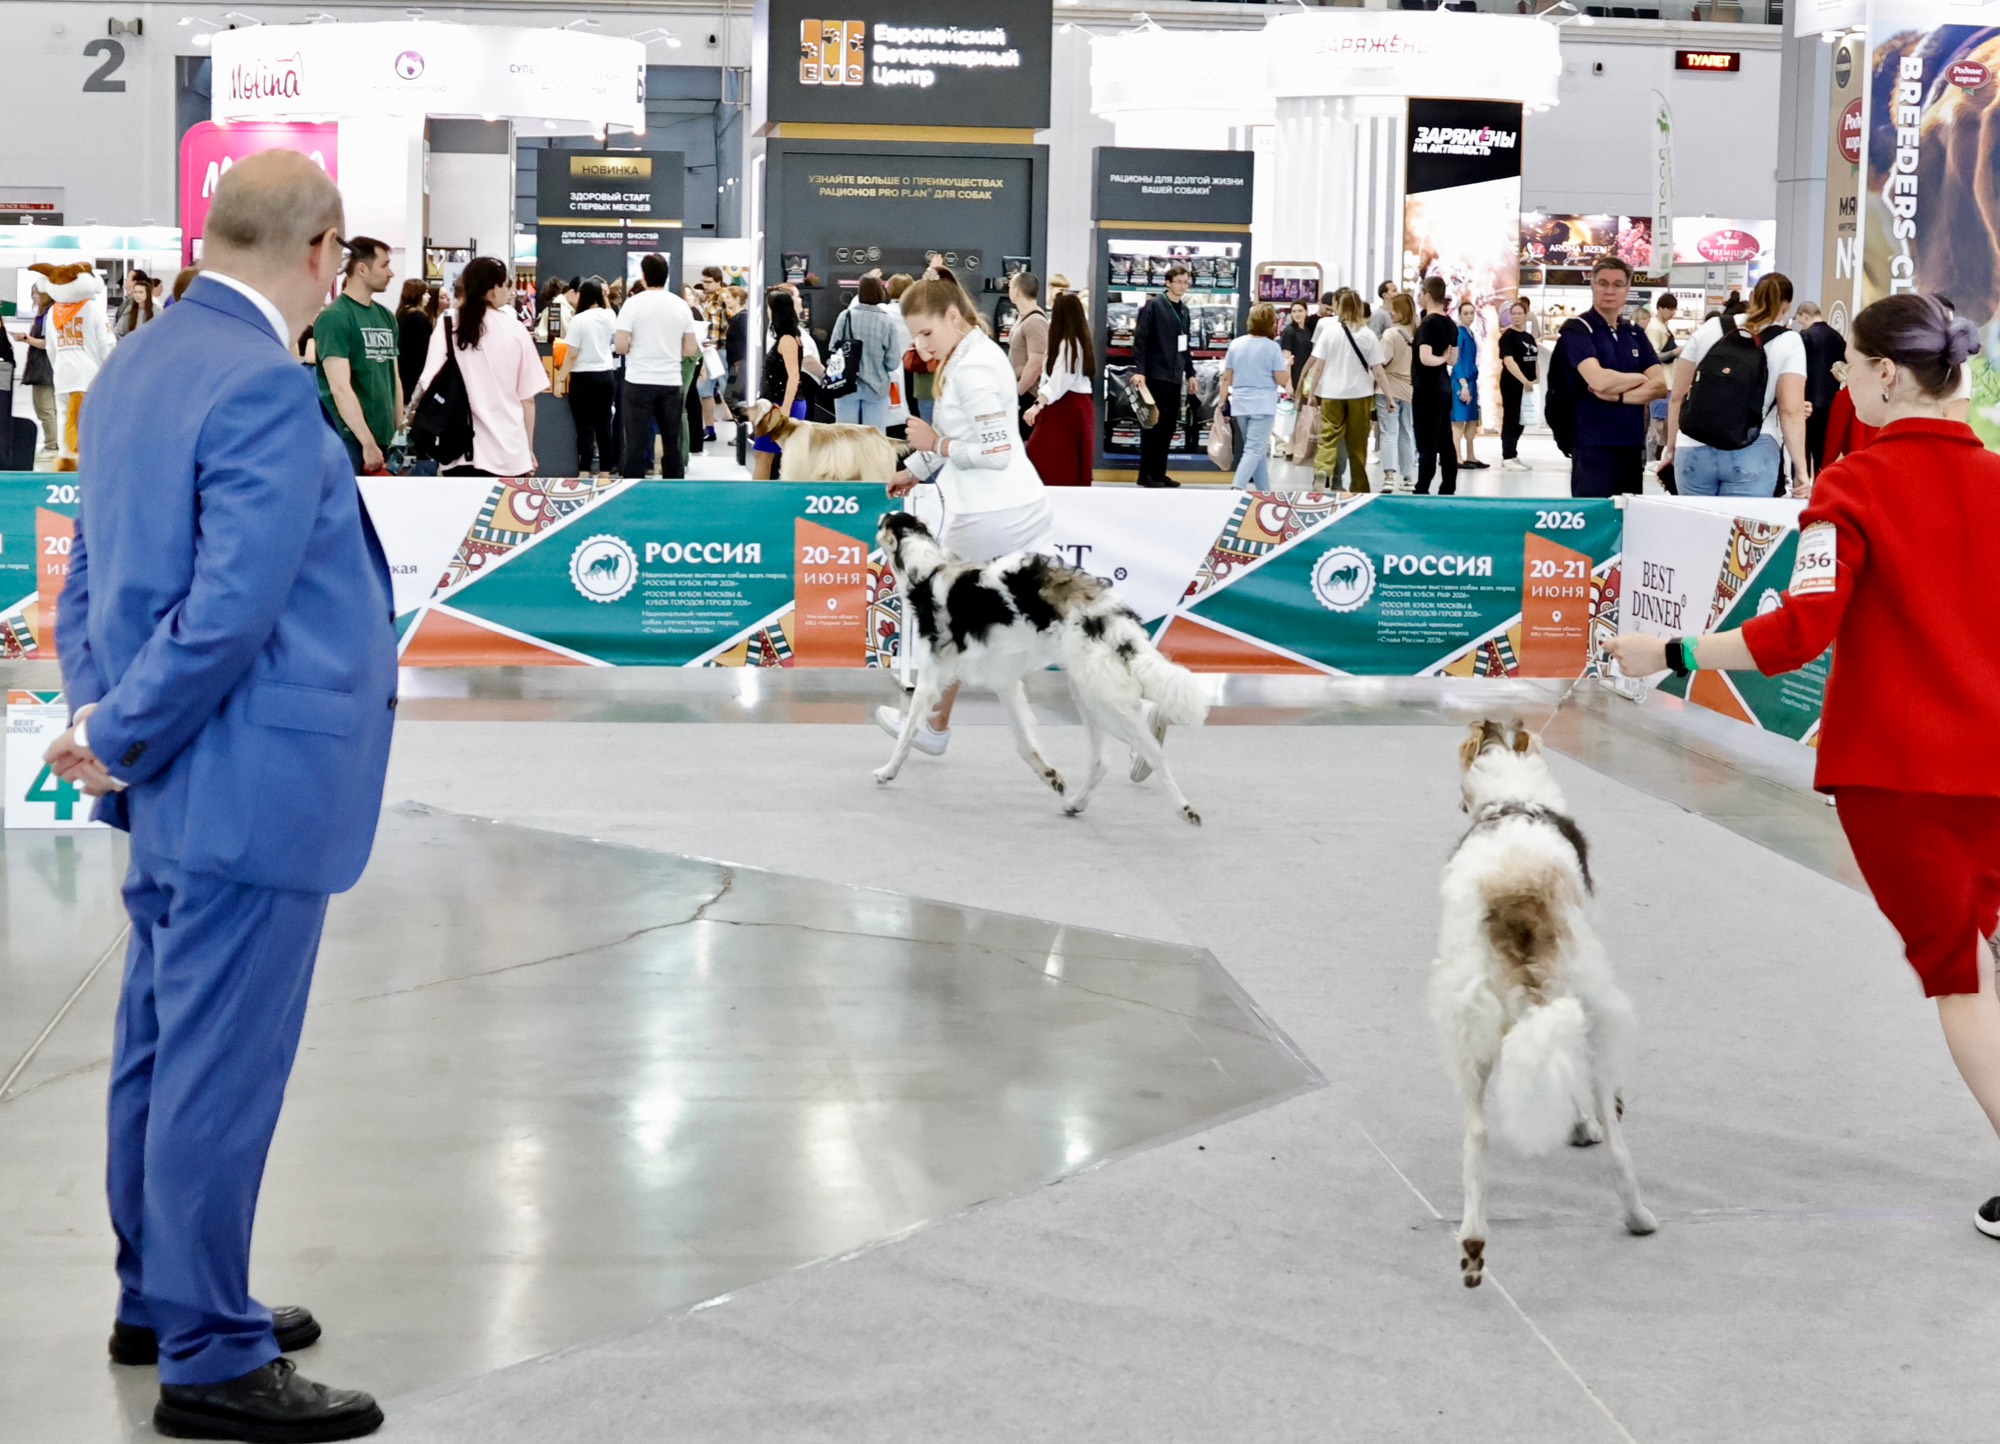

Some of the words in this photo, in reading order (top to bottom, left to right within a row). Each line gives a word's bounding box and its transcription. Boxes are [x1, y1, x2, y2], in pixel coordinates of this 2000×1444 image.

[874, 24, 1006, 45] Европейский
[873, 45, 1020, 67] Ветеринарный
[1687, 54, 1731, 67] ТУАЛЕТ
[82, 39, 126, 92] 2
[1952, 66, 1983, 76] Родные
[872, 66, 934, 87] Центр
[1954, 76, 1981, 84] корма
[1428, 143, 1491, 156] АКТИВНОСТЬ
[1892, 56, 1924, 240] BREEDERS
[582, 165, 639, 175] НОВИНКА
[809, 175, 855, 184] УЗНАЙТЕ
[857, 175, 900, 184] БОЛЬШЕ
[902, 177, 910, 185] О
[913, 177, 1004, 188] ПРЕИМУЩЕСТВАХ
[1110, 174, 1153, 184] РАЦИОНЫ
[1154, 175, 1172, 184] ДЛЯ
[1174, 175, 1211, 185] ДОЛГОЙ
[1212, 177, 1244, 185] ЖИЗНИ
[819, 187, 876, 197] РАЦИОНОВ
[878, 188, 899, 197] PRO
[934, 189, 955, 199] ДЛЯ
[958, 190, 992, 199] СОБАК
[1142, 185, 1172, 194] ВАШЕЙ
[570, 192, 621, 201] ЗДОРОВЫЙ
[623, 193, 651, 202] СТАРТ
[569, 202, 576, 210] С
[577, 202, 611, 211] ПЕРВЫХ
[612, 203, 651, 212] МЕСЯЦЕВ
[1839, 196, 1857, 216] МЯ
[577, 231, 606, 239] ОСОБЫХ
[1549, 243, 1581, 253] AROMA
[1583, 245, 1608, 254] DZEN
[981, 430, 1008, 443] 3535
[805, 495, 860, 514] 2026
[1534, 510, 1586, 529] 2026
[645, 542, 761, 564] РОССИЯ
[802, 546, 860, 564] 20-21
[1383, 554, 1492, 576] РОССИЯ
[1530, 560, 1586, 578] 20-21
[804, 573, 860, 584] ИЮНЯ
[1642, 560, 1675, 594] BEST
[1532, 586, 1584, 597] ИЮНЯ
[24, 762, 80, 821] 4
